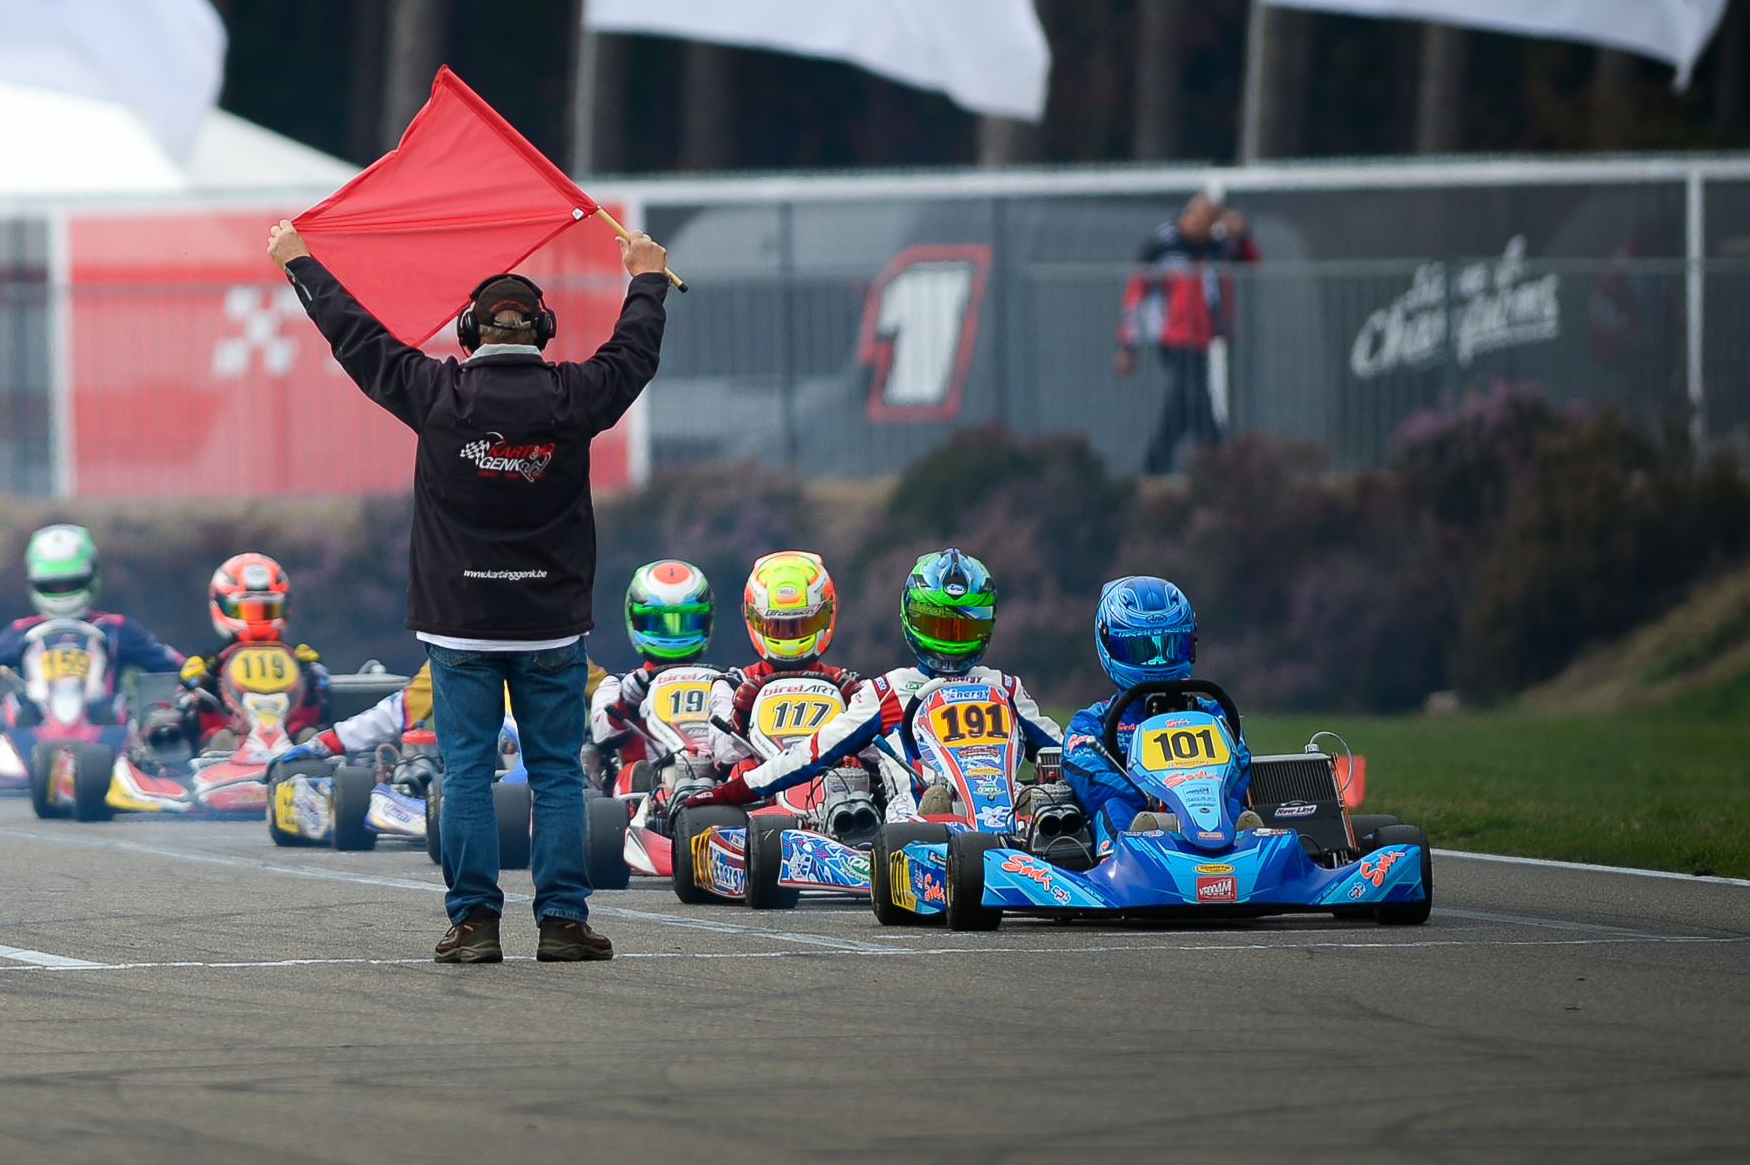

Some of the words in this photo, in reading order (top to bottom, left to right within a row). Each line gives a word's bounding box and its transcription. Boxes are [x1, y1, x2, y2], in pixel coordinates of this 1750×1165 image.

[864, 251, 985, 416] 1
[479, 457, 524, 472] GENK
[772, 700, 832, 731] 117
[941, 704, 1009, 742] 191
[1153, 729, 1216, 762] 101
[1001, 854, 1054, 893] Sodi
